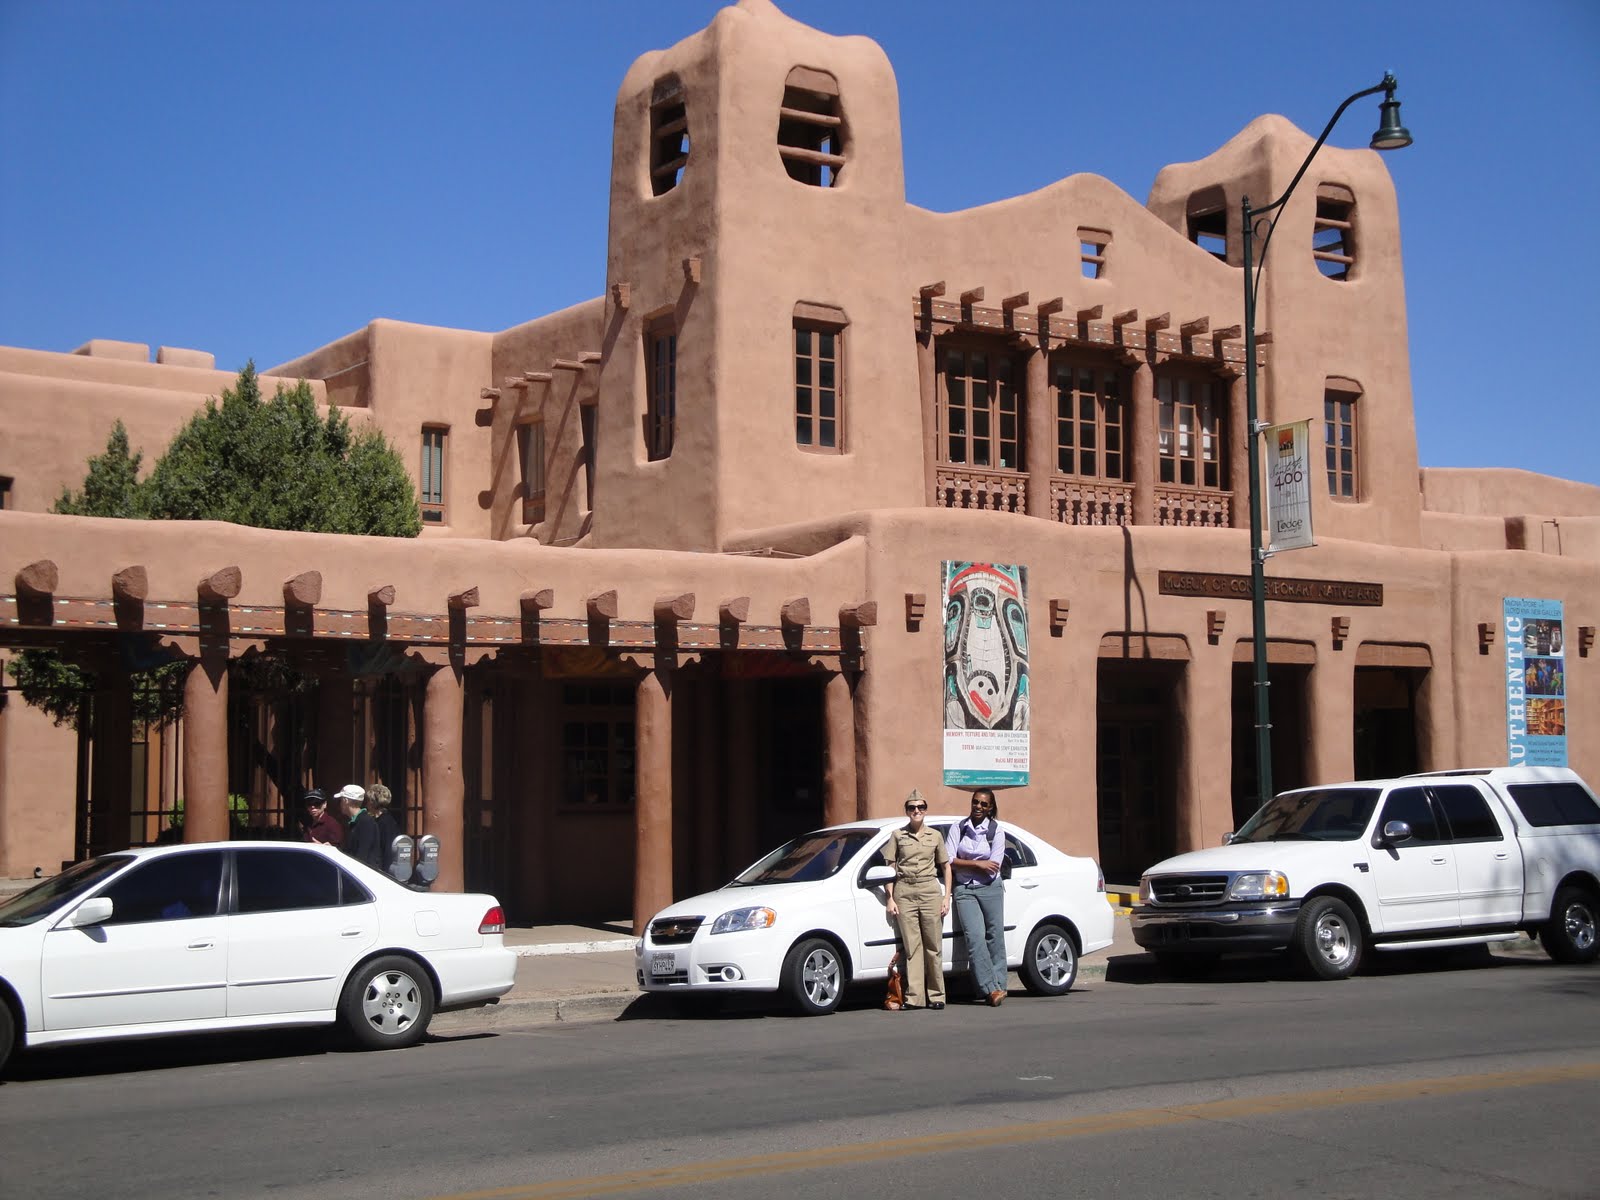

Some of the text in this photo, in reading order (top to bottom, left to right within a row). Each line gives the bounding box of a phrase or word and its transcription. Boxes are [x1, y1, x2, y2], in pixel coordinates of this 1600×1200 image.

[1274, 471, 1303, 491] 400
[1163, 575, 1381, 601] MUSEUM OF CONEMPORARY NATIVE ARTS
